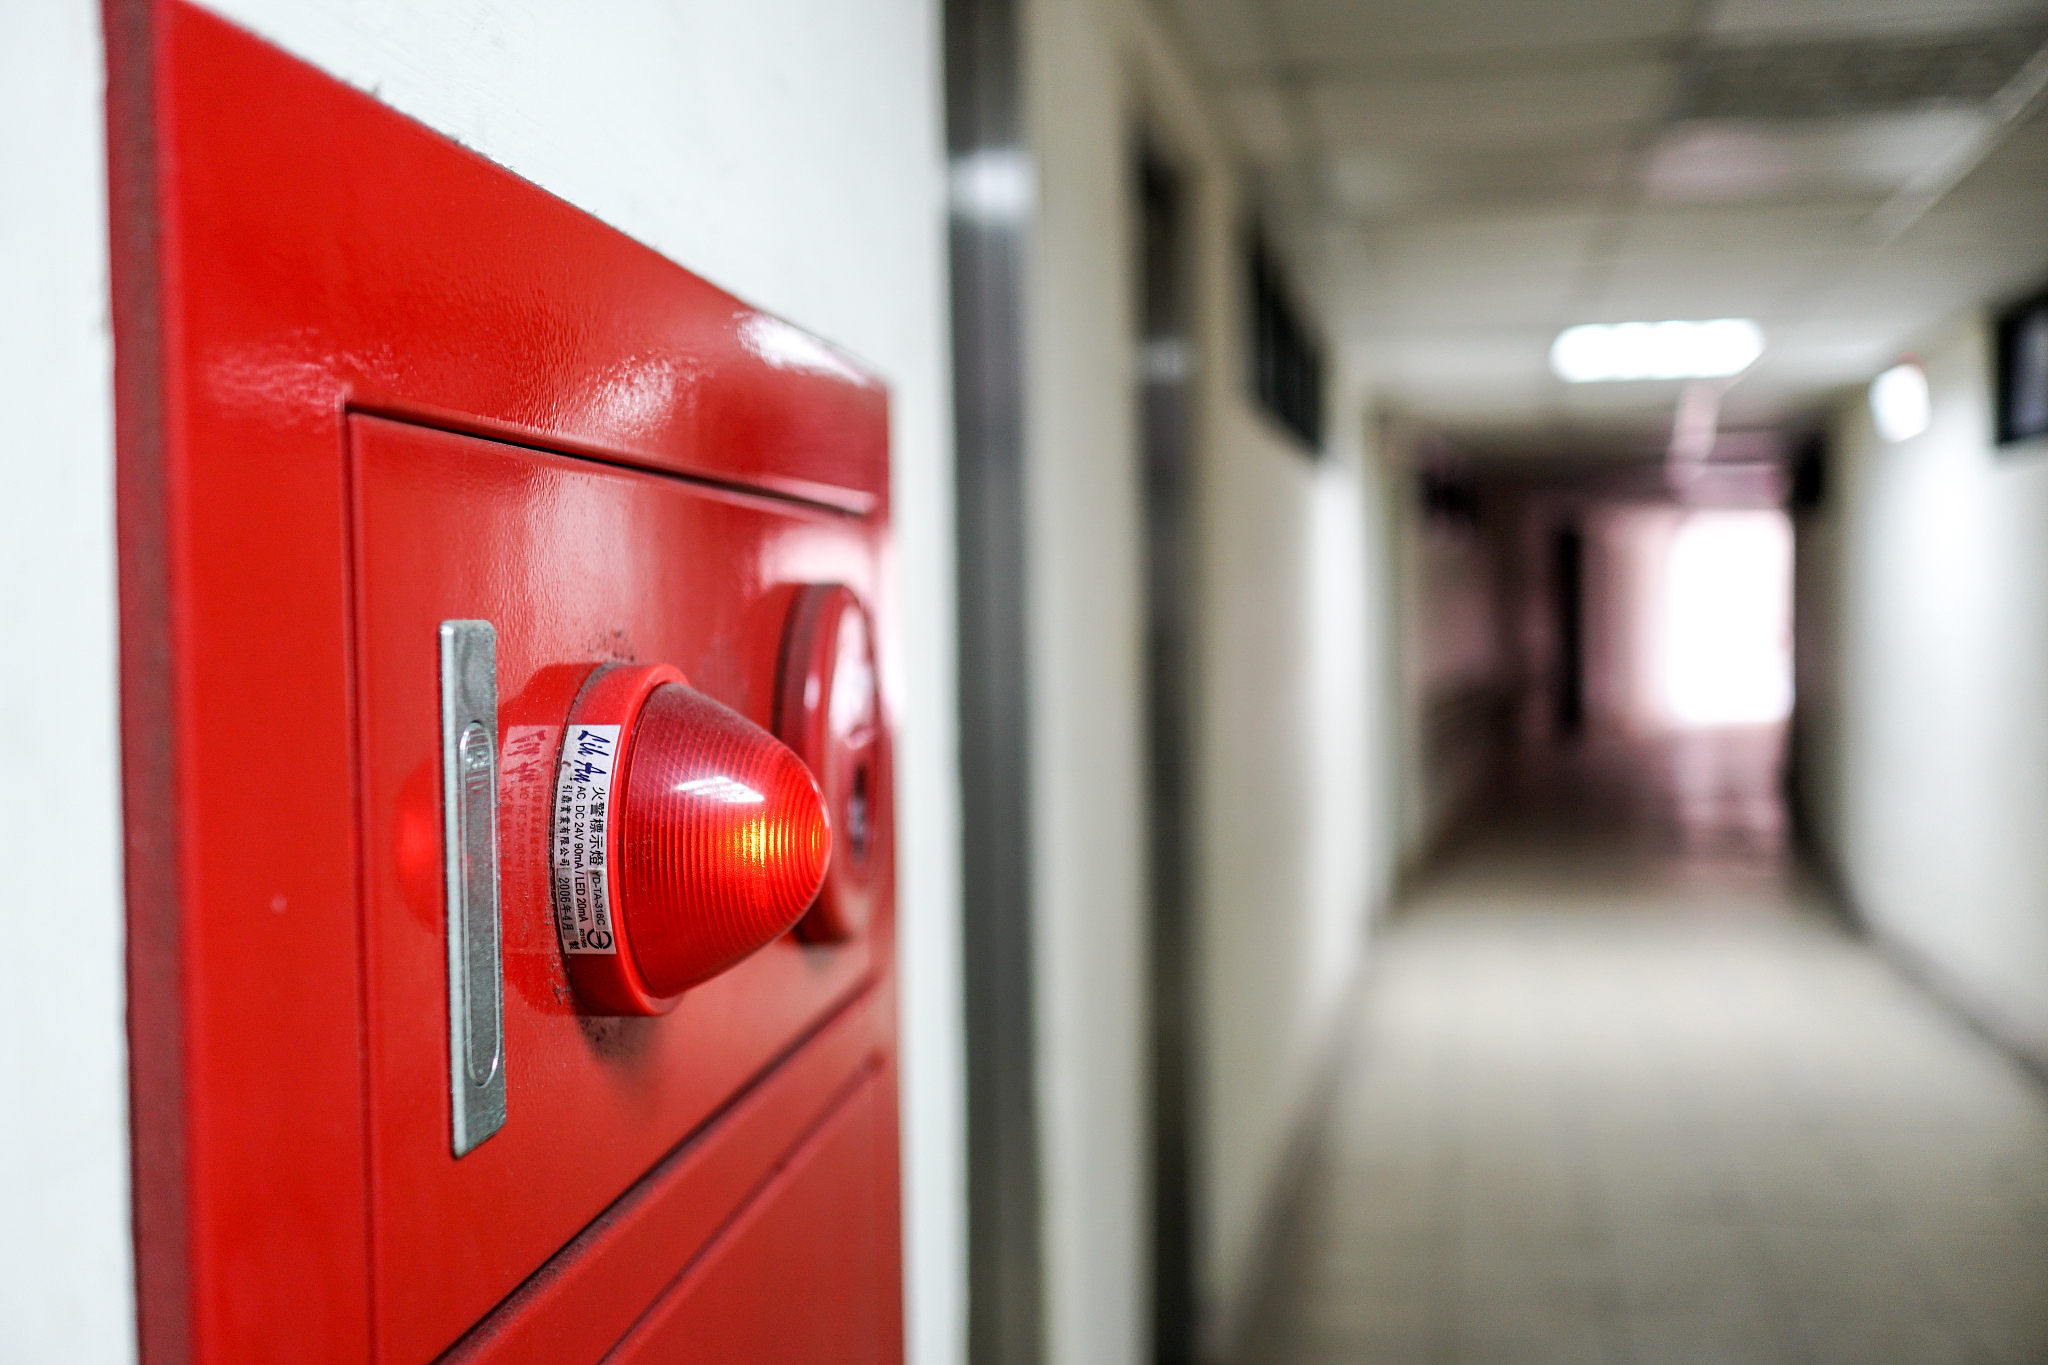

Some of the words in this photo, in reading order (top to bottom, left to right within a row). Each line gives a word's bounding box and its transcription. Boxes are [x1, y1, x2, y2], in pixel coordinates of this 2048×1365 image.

[575, 805, 585, 819] DC
[574, 822, 584, 840] 24V
[589, 786, 606, 866] 火警標示燈
[574, 842, 584, 868] 90mA
[575, 877, 586, 896] LED
[592, 870, 606, 926] YD-TA-316C
[558, 877, 574, 931] 2006年4月
[576, 897, 588, 923] 20mA
